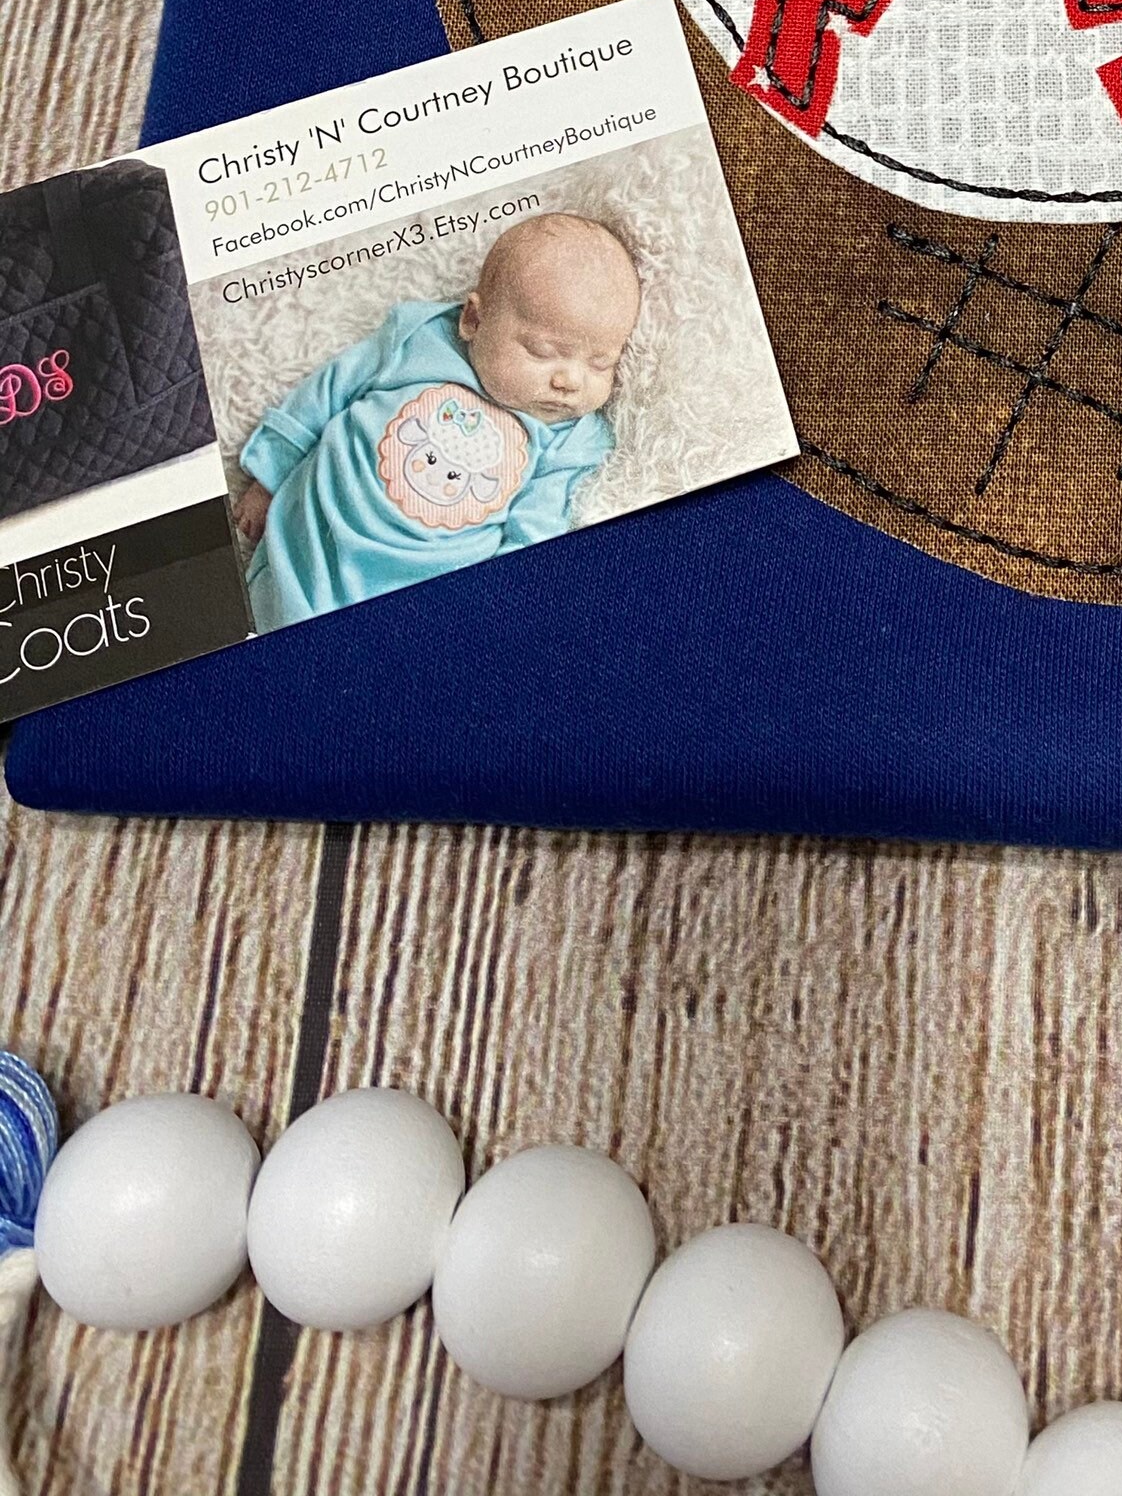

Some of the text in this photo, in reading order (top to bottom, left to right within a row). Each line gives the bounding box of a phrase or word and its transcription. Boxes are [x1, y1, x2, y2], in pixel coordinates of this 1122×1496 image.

[198, 139, 300, 184] Christy
[357, 80, 493, 134] Courtney
[502, 38, 634, 92] Boutique
[204, 146, 389, 222] 901-212-4712
[211, 107, 658, 257] Facebook.com/ChristyNCourtneyBoutique
[222, 191, 541, 304] ChristyscornerX3.Etsy.com
